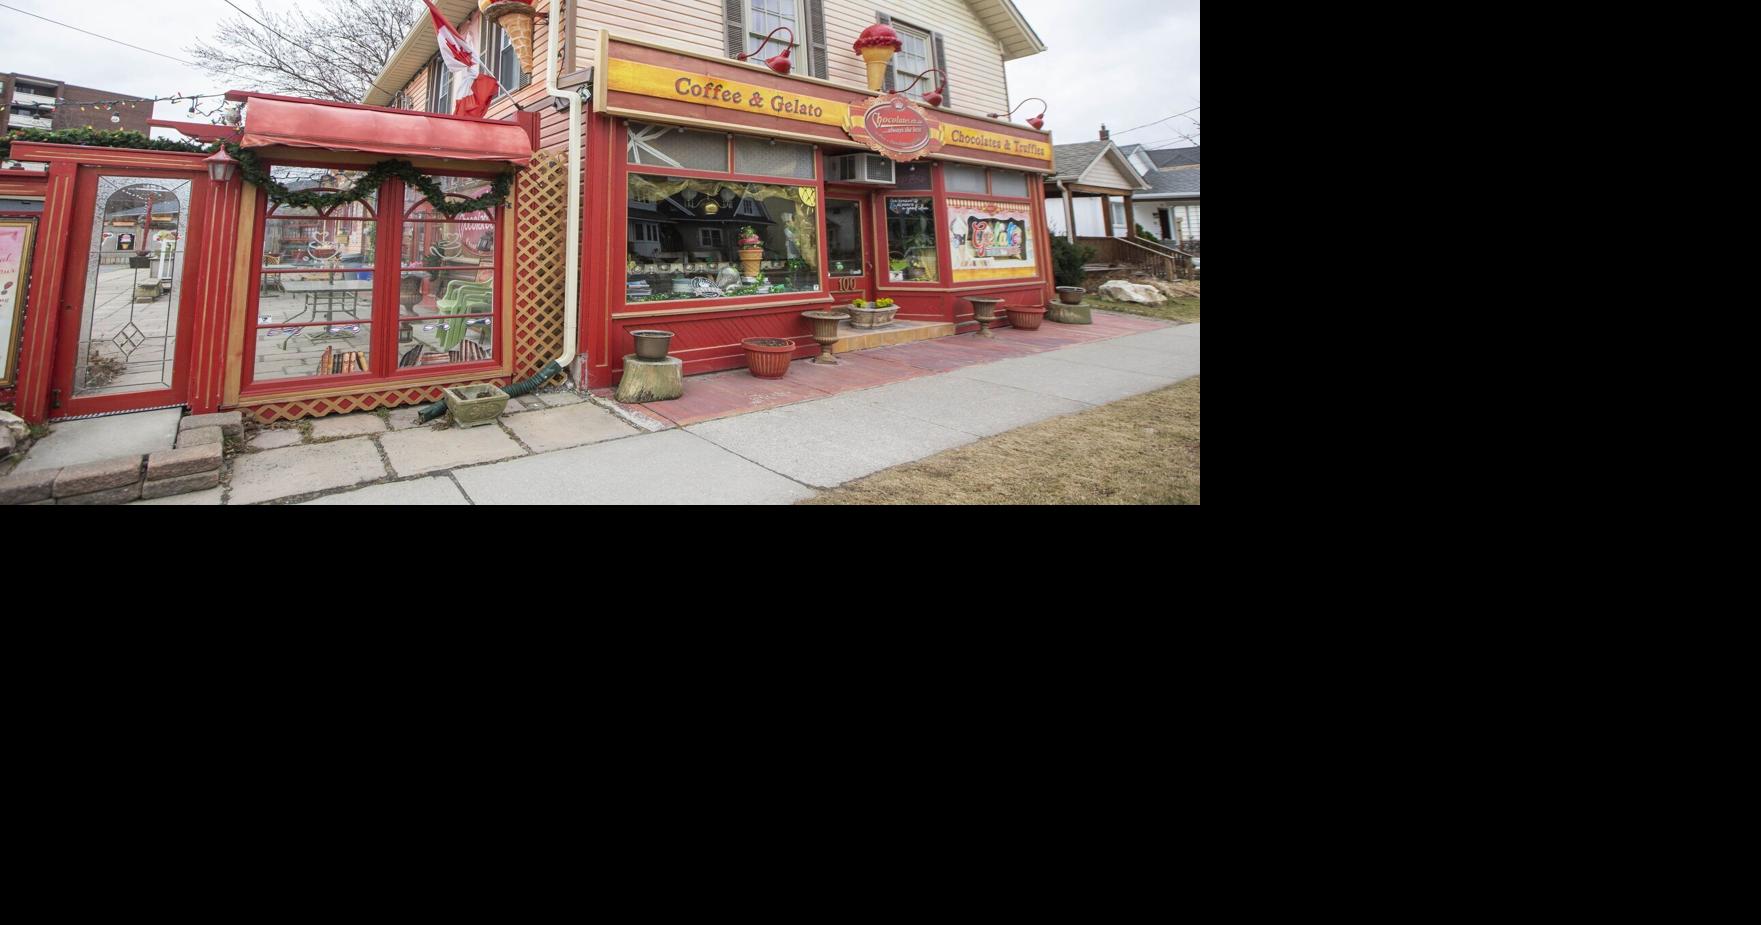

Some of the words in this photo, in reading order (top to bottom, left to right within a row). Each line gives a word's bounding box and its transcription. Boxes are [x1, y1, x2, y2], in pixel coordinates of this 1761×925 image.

[675, 77, 742, 104] Coffee
[749, 91, 764, 108] &
[770, 95, 823, 118] Gelato
[951, 129, 1001, 149] Chocolates
[1004, 141, 1011, 150] &
[1014, 141, 1045, 156] Truffles
